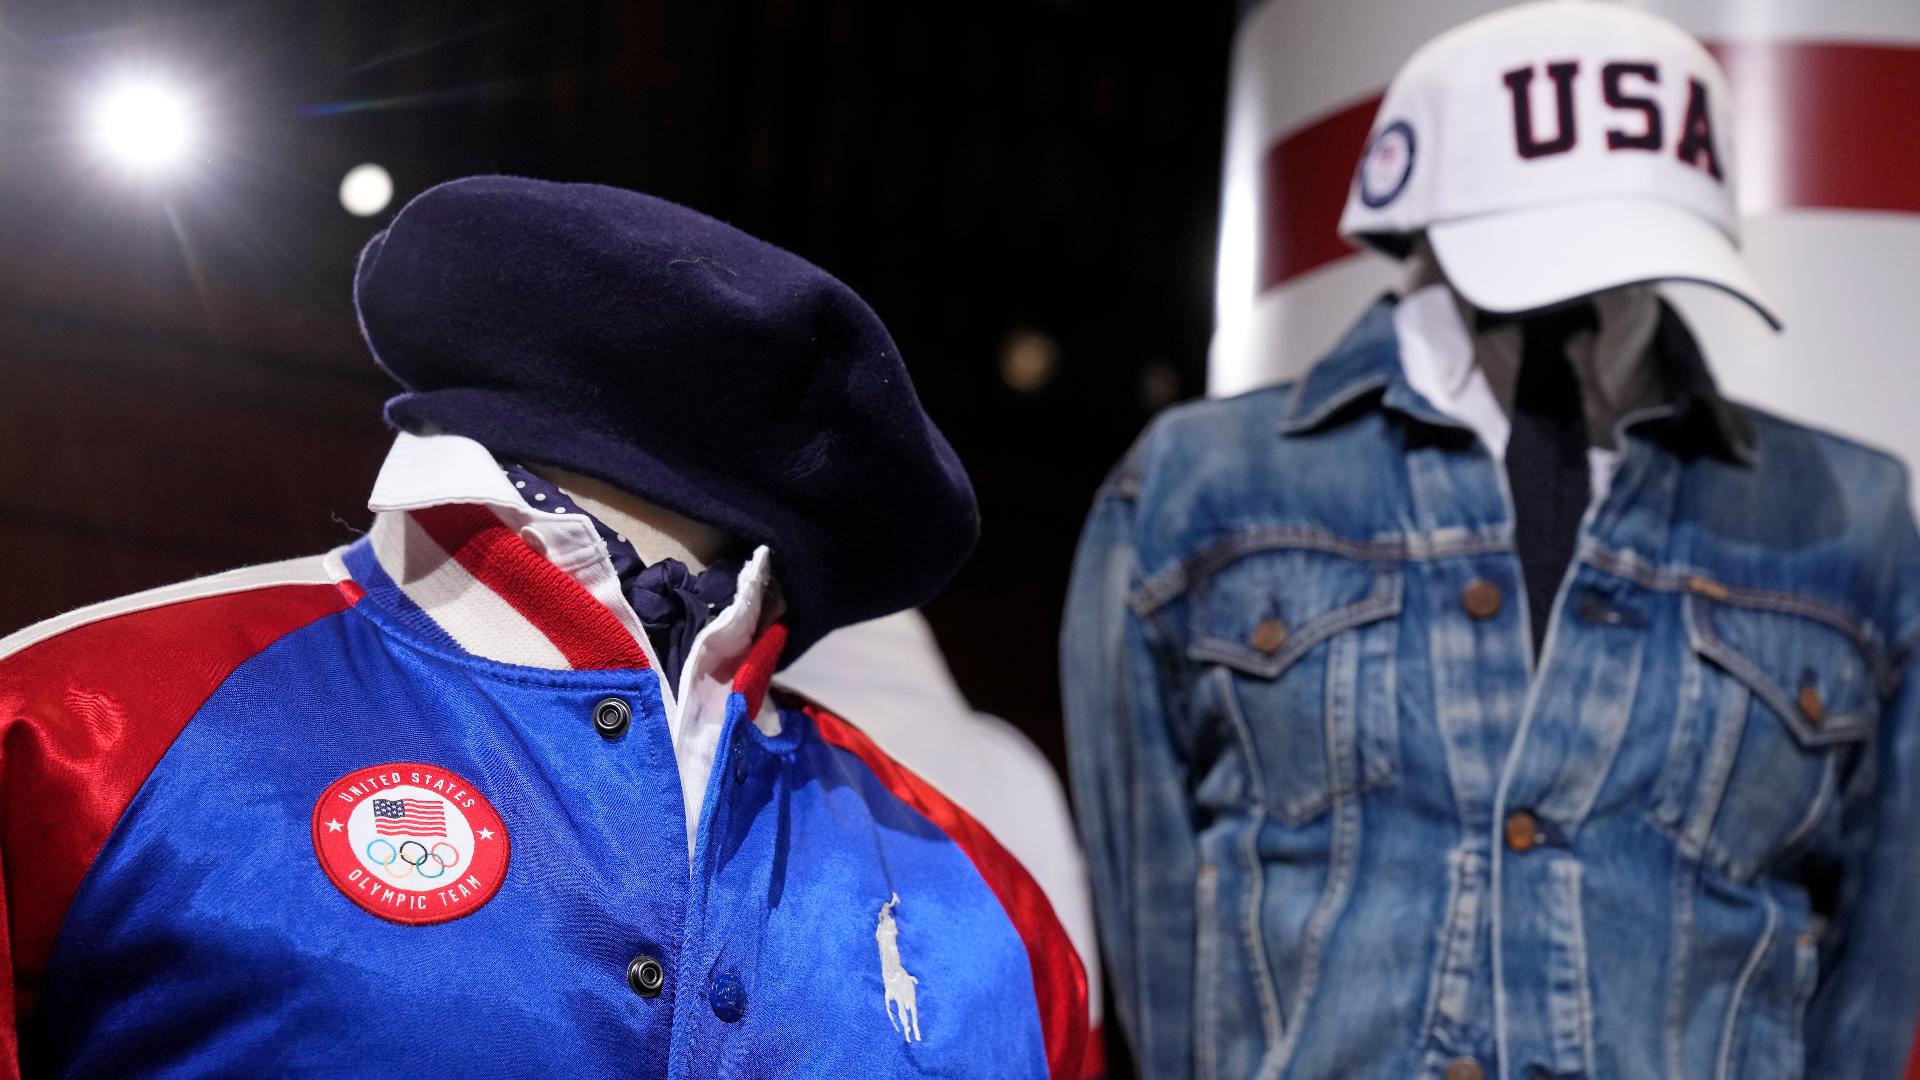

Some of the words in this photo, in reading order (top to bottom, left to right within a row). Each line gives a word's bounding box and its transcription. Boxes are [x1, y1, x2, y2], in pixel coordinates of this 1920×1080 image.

[1502, 59, 1725, 183] USA
[338, 772, 401, 803] UNITED
[411, 772, 475, 808] STATES
[348, 868, 427, 910] OLYMPIC
[438, 875, 482, 906] TEAM
